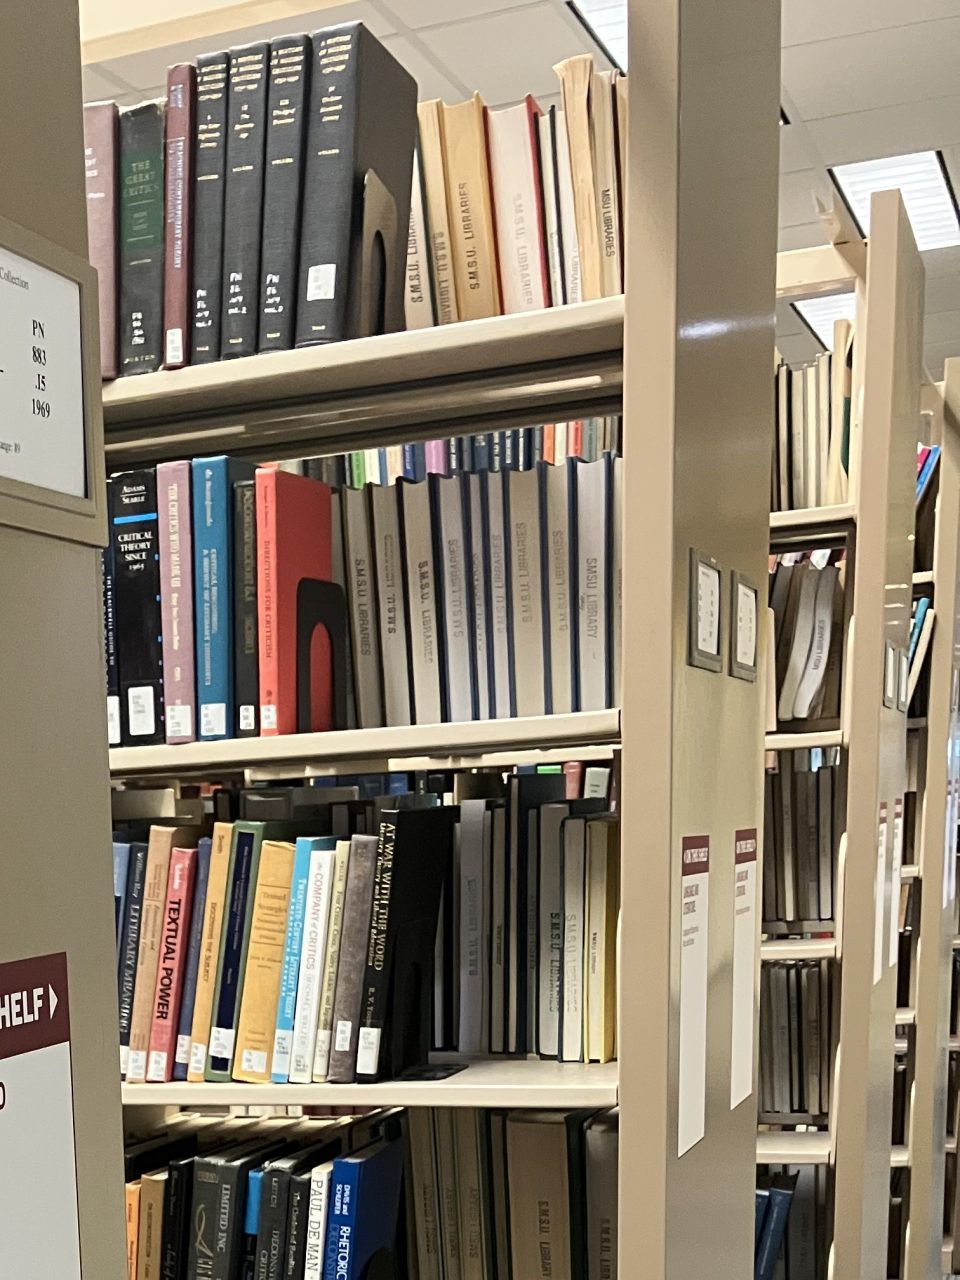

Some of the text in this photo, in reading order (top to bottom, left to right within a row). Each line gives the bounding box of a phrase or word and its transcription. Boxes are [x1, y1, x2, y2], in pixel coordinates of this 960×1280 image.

[600, 188, 616, 258] MSU LIBRARIES
[0, 265, 30, 290] Collection
[32, 319, 45, 339] PN
[32, 346, 47, 366] 883
[31, 398, 50, 418] 1969
[118, 532, 153, 542] CRITICAL
[120, 541, 152, 552] THEORY
[125, 552, 147, 562] SINCE
[264, 595, 272, 611] FOR
[587, 558, 598, 638] SMSU LIBRARY
[309, 872, 325, 922] COMPANY
[373, 823, 397, 971] AT WAR WITH THE WORD
[123, 904, 141, 966] LITERARY
[305, 931, 319, 971] CRITICS
[156, 897, 182, 1020] TEXTUAL POWER
[217, 1183, 231, 1253] LIMITED INC
[305, 1179, 325, 1272] PAUL DE MAN
[335, 1225, 352, 1280] RHETORIC
